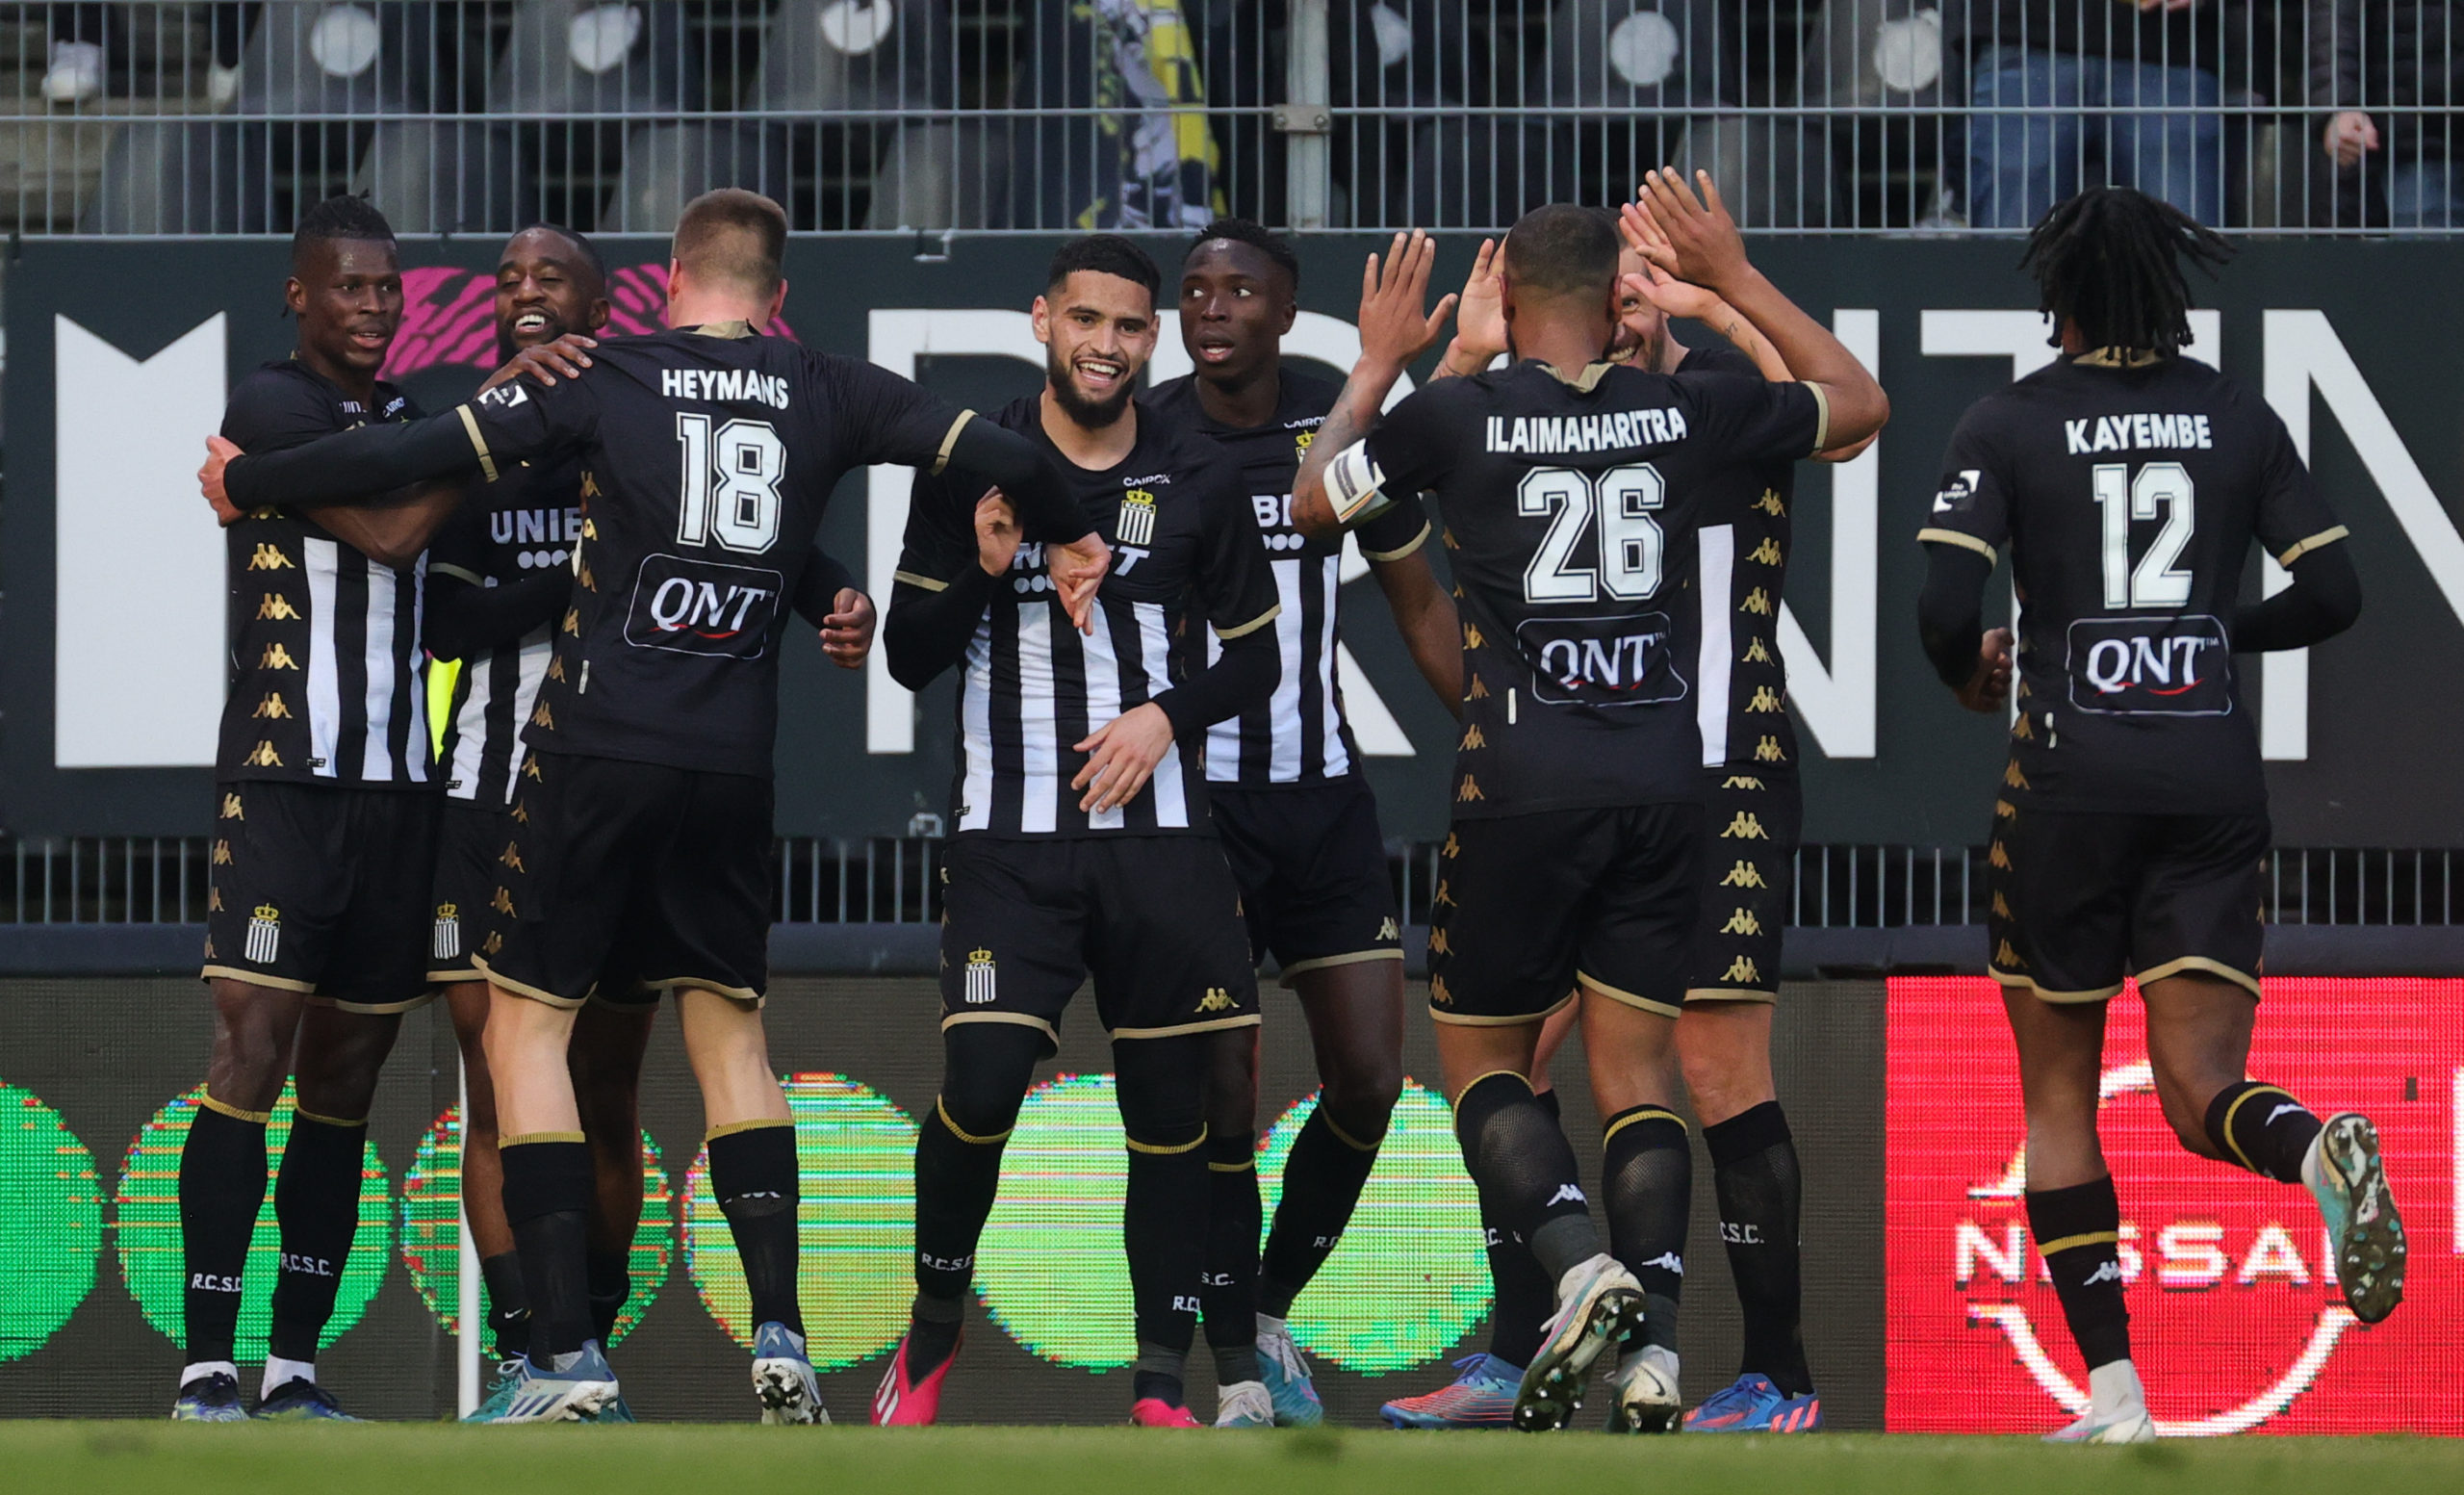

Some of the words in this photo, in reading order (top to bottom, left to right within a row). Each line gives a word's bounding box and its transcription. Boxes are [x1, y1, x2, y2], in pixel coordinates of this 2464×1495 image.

[661, 369, 789, 410] HEYMANS
[1485, 406, 1688, 454] ILAIMAHARITRA
[2065, 413, 2213, 454] KAYEMBE
[676, 411, 787, 555] 18
[1516, 461, 1665, 604] 26
[2092, 461, 2194, 609] 12
[650, 577, 767, 632] QNT
[1540, 632, 1655, 690] QNT
[2086, 636, 2205, 693] QNT
